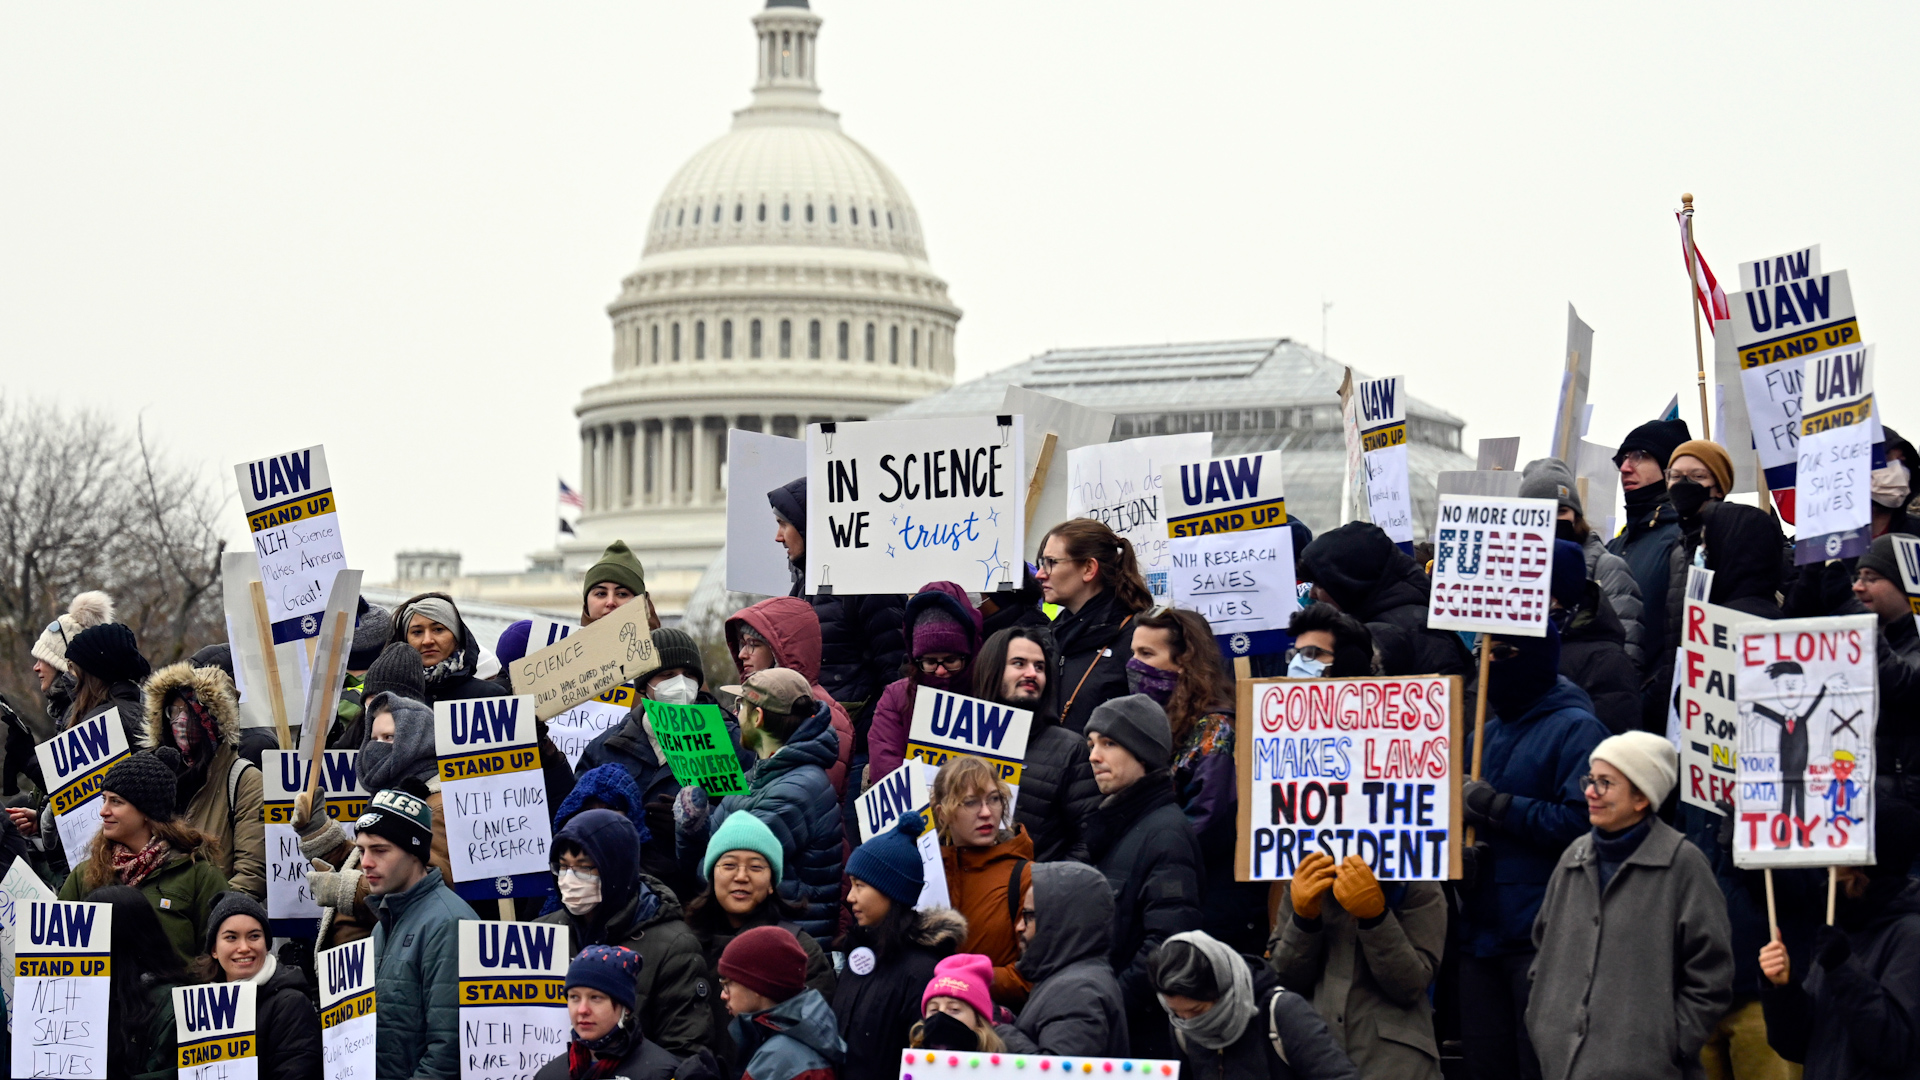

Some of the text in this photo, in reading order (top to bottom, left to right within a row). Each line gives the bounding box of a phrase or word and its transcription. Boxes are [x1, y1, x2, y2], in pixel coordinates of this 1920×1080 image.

[1745, 275, 1830, 333] UAW
[1745, 326, 1854, 368] STAND UP
[1815, 348, 1867, 403] UAW
[1360, 378, 1396, 422] UAW
[1363, 428, 1404, 452] STAND UP
[1805, 411, 1855, 436] STAND
[249, 449, 311, 502] UAW
[827, 445, 1003, 503] IN SCIENCE
[1799, 452, 1824, 474] OUR
[1070, 460, 1106, 505] And
[1180, 455, 1263, 507] UAW
[1809, 468, 1855, 496] SAVES
[252, 497, 330, 532] STAND UP
[1442, 505, 1551, 527] NO MORE CUTS!
[1807, 491, 1854, 518] LIVES
[828, 511, 980, 551] WE trust
[1174, 506, 1280, 537] STAND UP
[256, 525, 334, 559] NIH Science
[1437, 529, 1547, 582] FUND
[261, 550, 344, 585] Makes America
[1172, 549, 1277, 569] NIH RESEARCH
[283, 580, 323, 612] Great!
[1193, 570, 1256, 591] SAVES
[1196, 600, 1253, 618] LIVES
[1434, 582, 1544, 622] SCIENCE!
[523, 641, 584, 685] SCIENCE
[1743, 630, 1861, 667] ELON'S
[560, 679, 577, 694] HAVE
[600, 660, 617, 674] YOUR
[562, 685, 590, 706] BRAIN
[593, 673, 615, 690] WORM
[600, 689, 628, 703] UP
[1260, 681, 1444, 733] CONGRESS
[450, 698, 519, 746] UAW
[930, 692, 1015, 751] UAW
[50, 715, 110, 778] UAW
[682, 733, 715, 752] THE
[911, 748, 950, 767] STA
[1254, 736, 1449, 781] MAKES LAWS
[281, 752, 358, 792] UAW
[444, 751, 535, 778] STAND UP
[1740, 756, 1775, 774] YOUR
[55, 774, 104, 811] STAND
[697, 773, 743, 794] HERE
[865, 765, 912, 835] UAW
[1743, 783, 1777, 801] DATA
[270, 804, 341, 822] STD
[372, 790, 423, 817] GLES
[455, 787, 544, 818] NIH FUNDS
[1271, 781, 1435, 826] NOT THE
[62, 813, 89, 840] THE
[472, 815, 532, 842] CANCER
[1742, 812, 1851, 850] TOYS
[468, 837, 545, 865] RESEARCH
[1253, 828, 1447, 879] PRESIDENT
[30, 902, 96, 947] UAW
[478, 923, 555, 970] UAW
[19, 961, 74, 976] STAND
[81, 961, 105, 976] UP
[327, 942, 366, 995] UAW
[32, 978, 81, 1015] NIH
[182, 984, 241, 1032] UAW
[466, 983, 566, 1001] STAND UP
[324, 996, 373, 1029] STAND UP
[33, 1017, 90, 1044] SAVES
[466, 1020, 562, 1048] NIH FUNDS
[32, 1051, 93, 1078] LIVES
[182, 1040, 250, 1066] STAND UP
[469, 1053, 510, 1071] RARE
